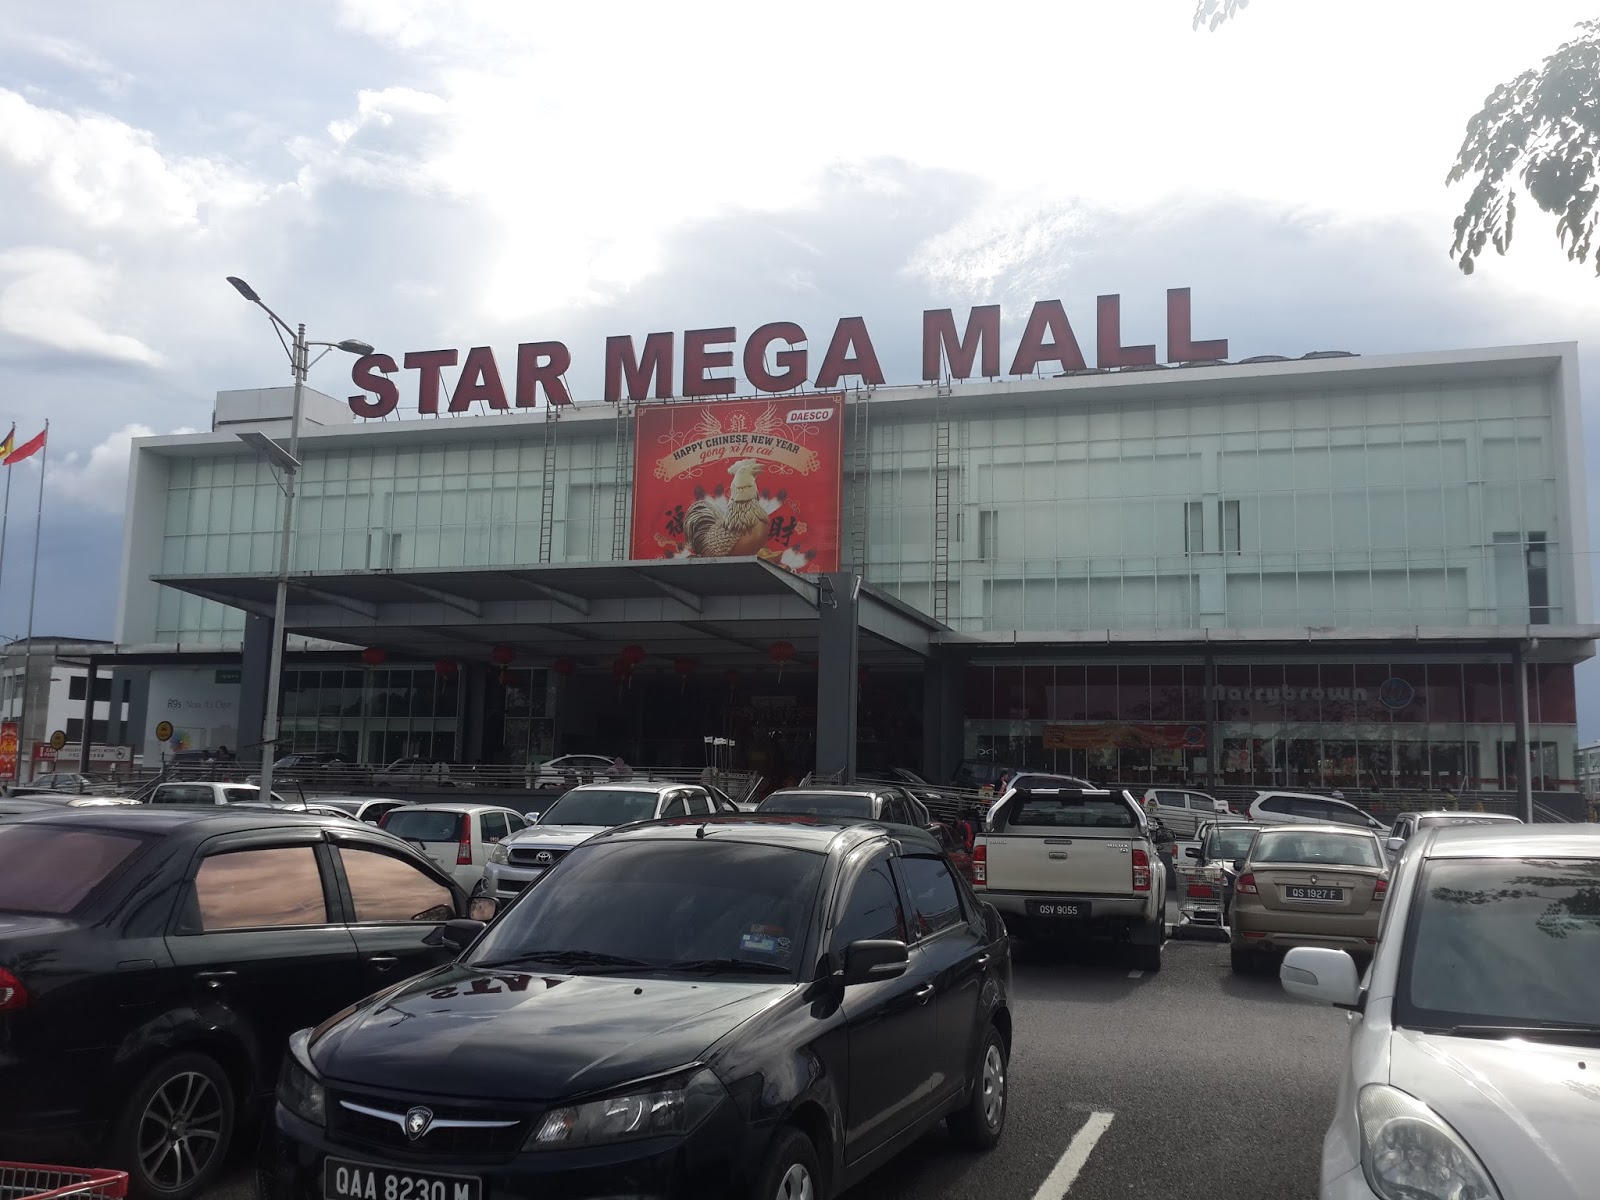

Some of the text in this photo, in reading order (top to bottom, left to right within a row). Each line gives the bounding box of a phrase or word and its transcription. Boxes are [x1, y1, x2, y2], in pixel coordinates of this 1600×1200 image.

[348, 287, 1229, 418] STAR MEGA MALL
[790, 410, 829, 421] DAESCO
[673, 434, 800, 460] HAPPY CHINESE NEW YEAR
[699, 442, 774, 463] gong xi fa cai
[1292, 888, 1336, 899] QS 1927 F
[1056, 905, 1078, 915] 9055
[336, 1166, 469, 1200] QAA 8230 M
